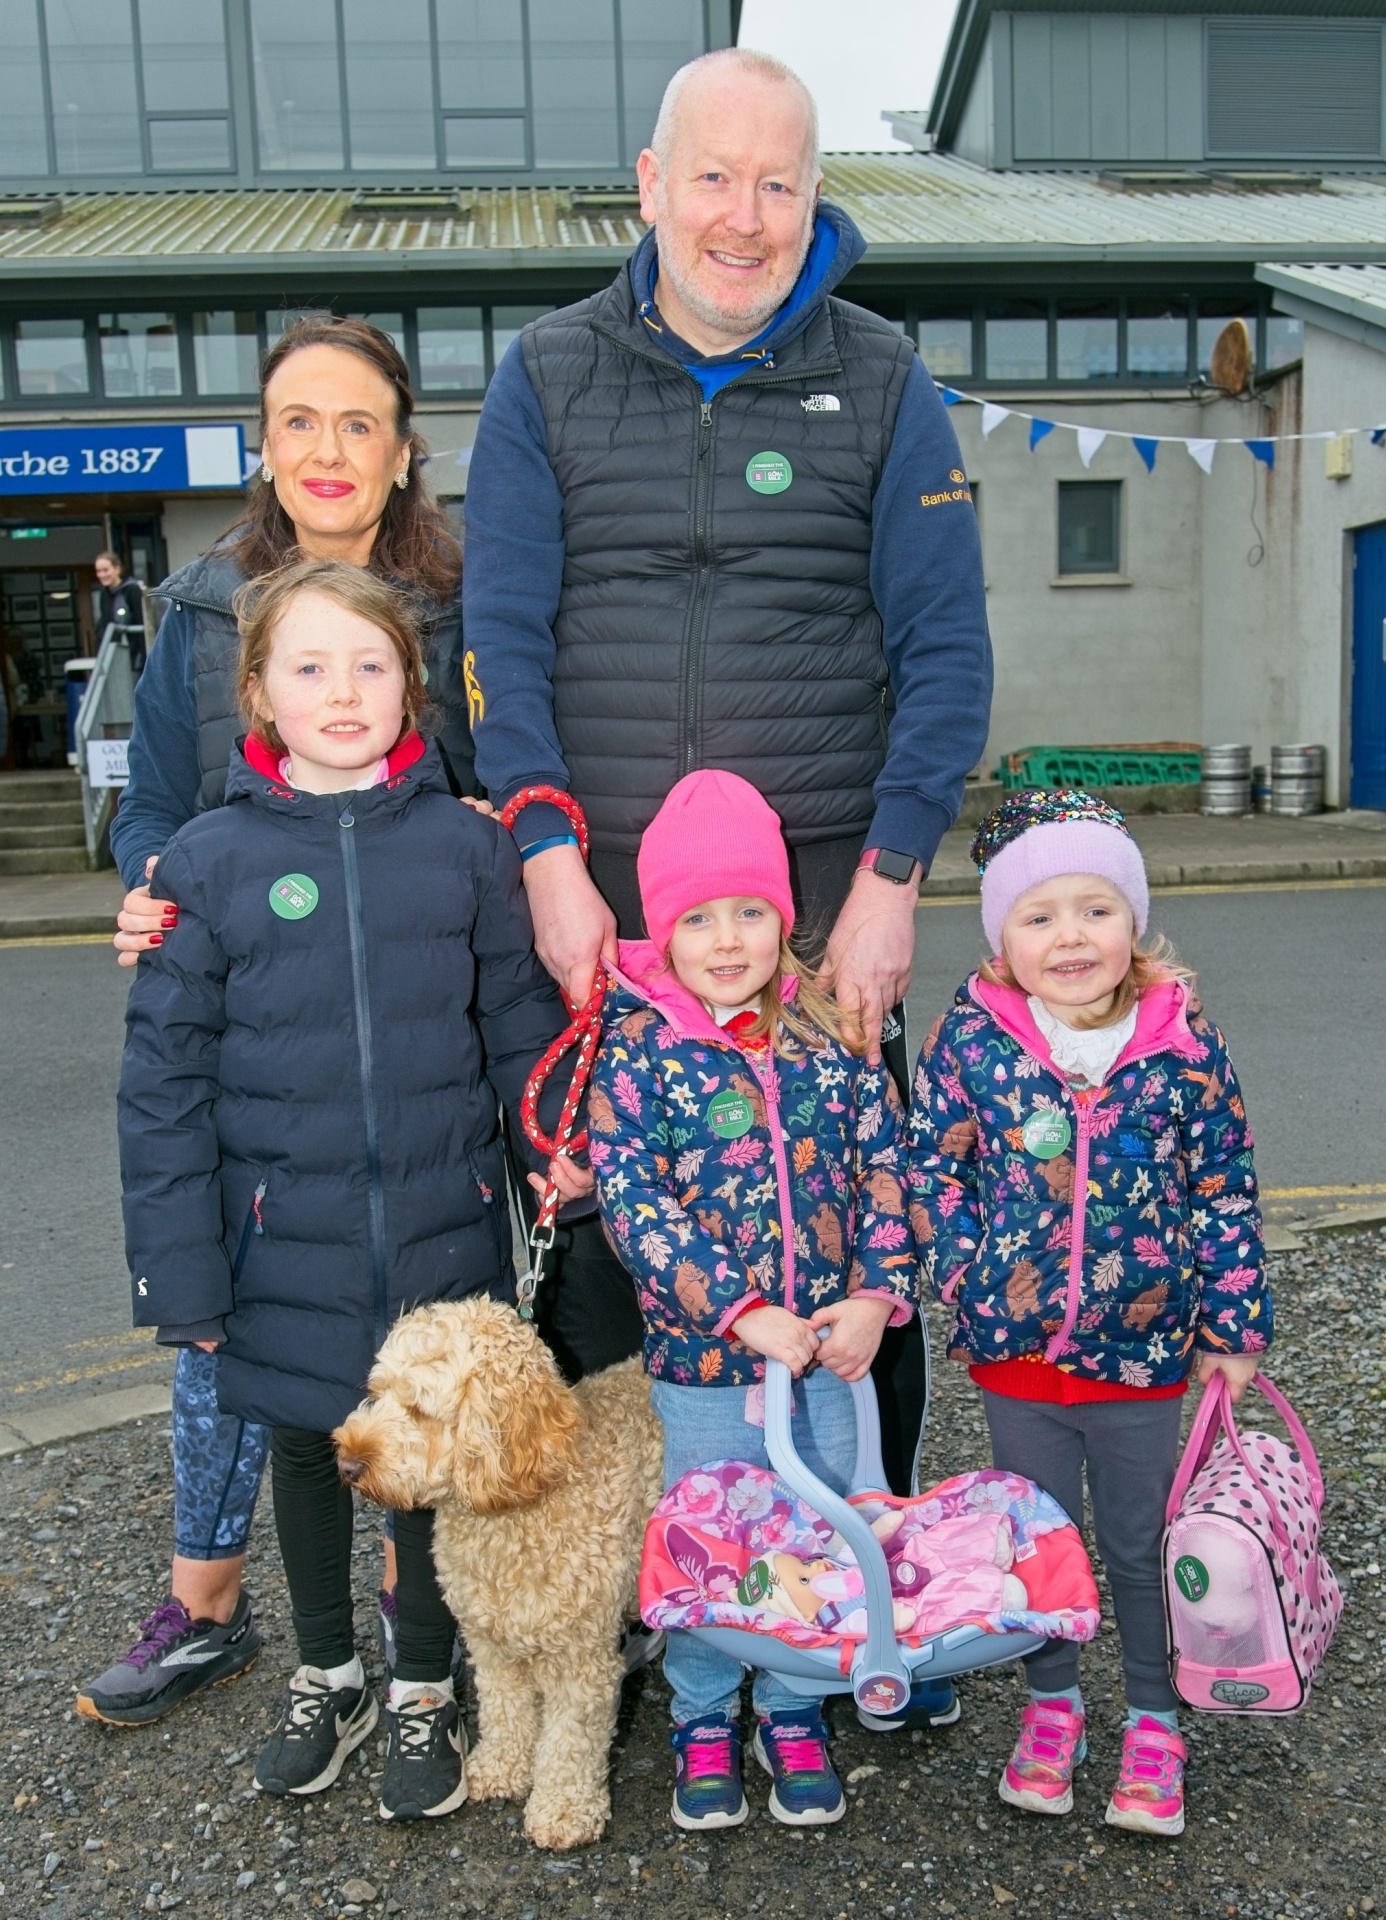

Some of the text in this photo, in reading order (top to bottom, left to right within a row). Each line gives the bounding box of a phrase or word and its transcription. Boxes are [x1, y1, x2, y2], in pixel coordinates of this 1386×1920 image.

[0, 447, 164, 476] the 1887
[921, 491, 952, 506] Bank
[952, 489, 963, 500] of
[880, 1025, 901, 1043] didas
[1216, 1683, 1263, 1698] Pucci
